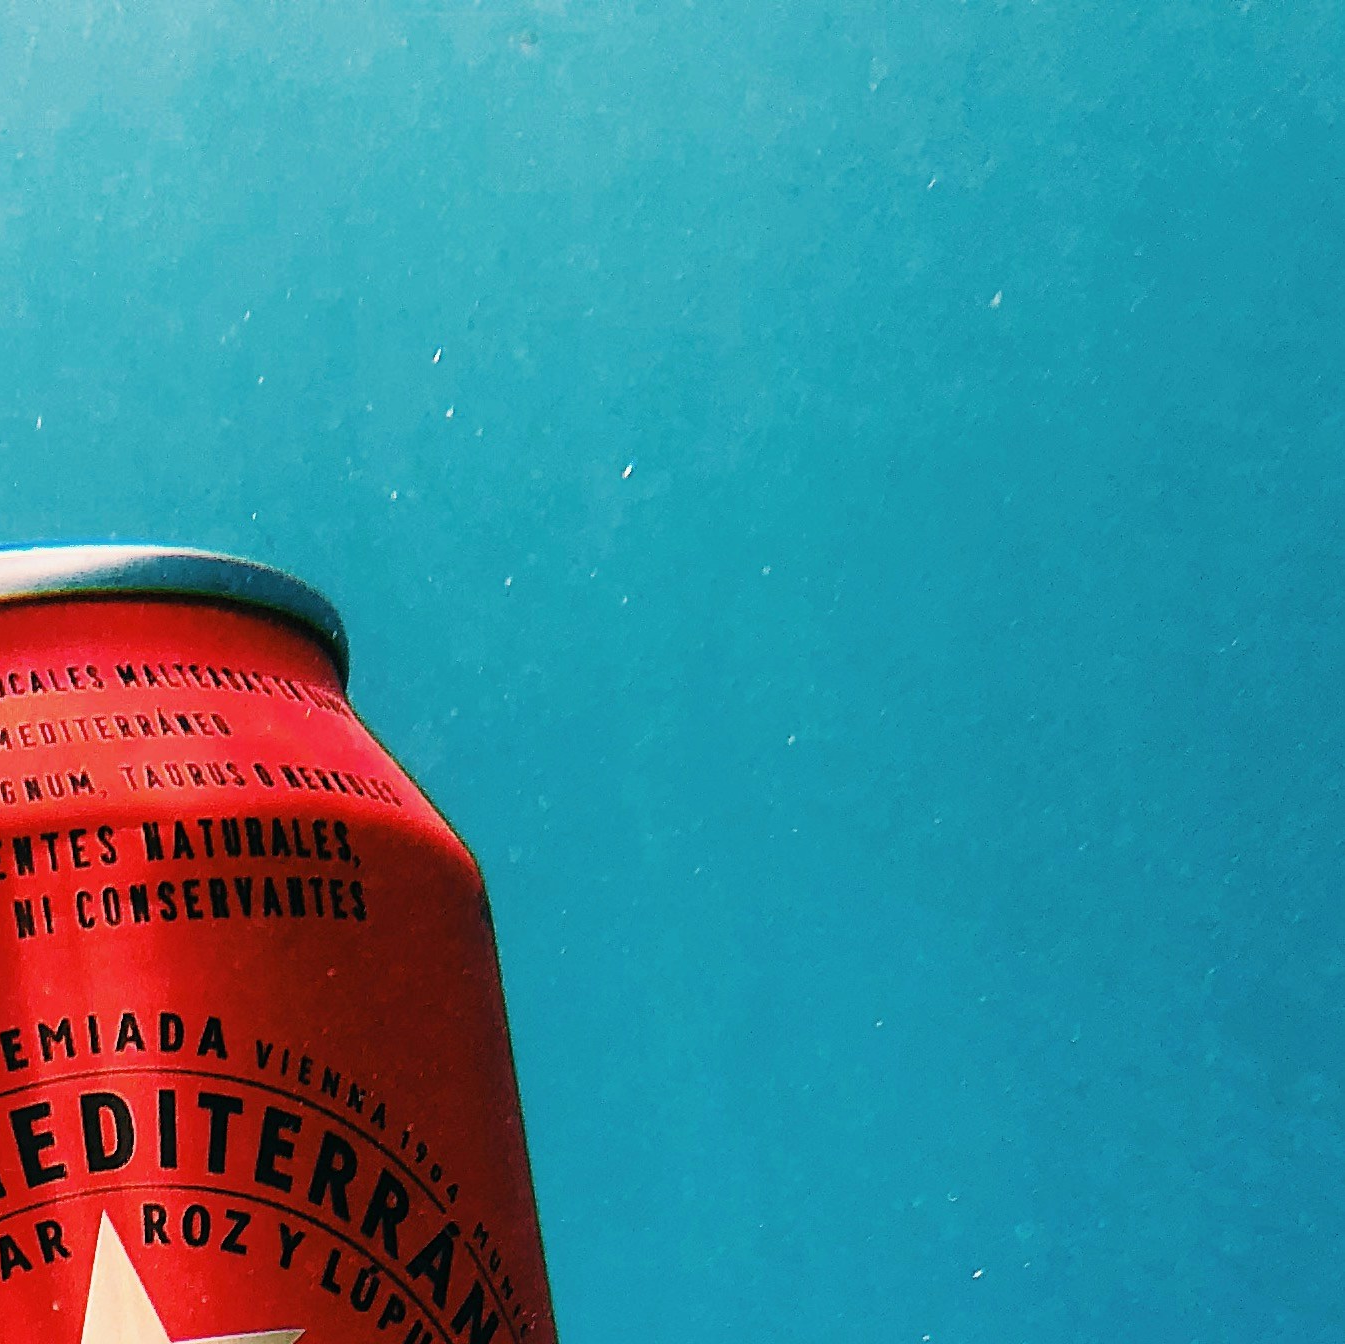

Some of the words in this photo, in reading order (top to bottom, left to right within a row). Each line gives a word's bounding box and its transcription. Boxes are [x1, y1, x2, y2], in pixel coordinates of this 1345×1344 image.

[120, 761, 245, 790] TAURUS
[252, 762, 275, 788] O
[141, 816, 361, 868] NATURALES,
[12, 895, 54, 939] NI
[75, 875, 368, 929] CONSERVANTES
[256, 1039, 386, 1130] VIENNA
[142, 1202, 250, 1255] ROZ
[279, 1222, 305, 1270] Y
